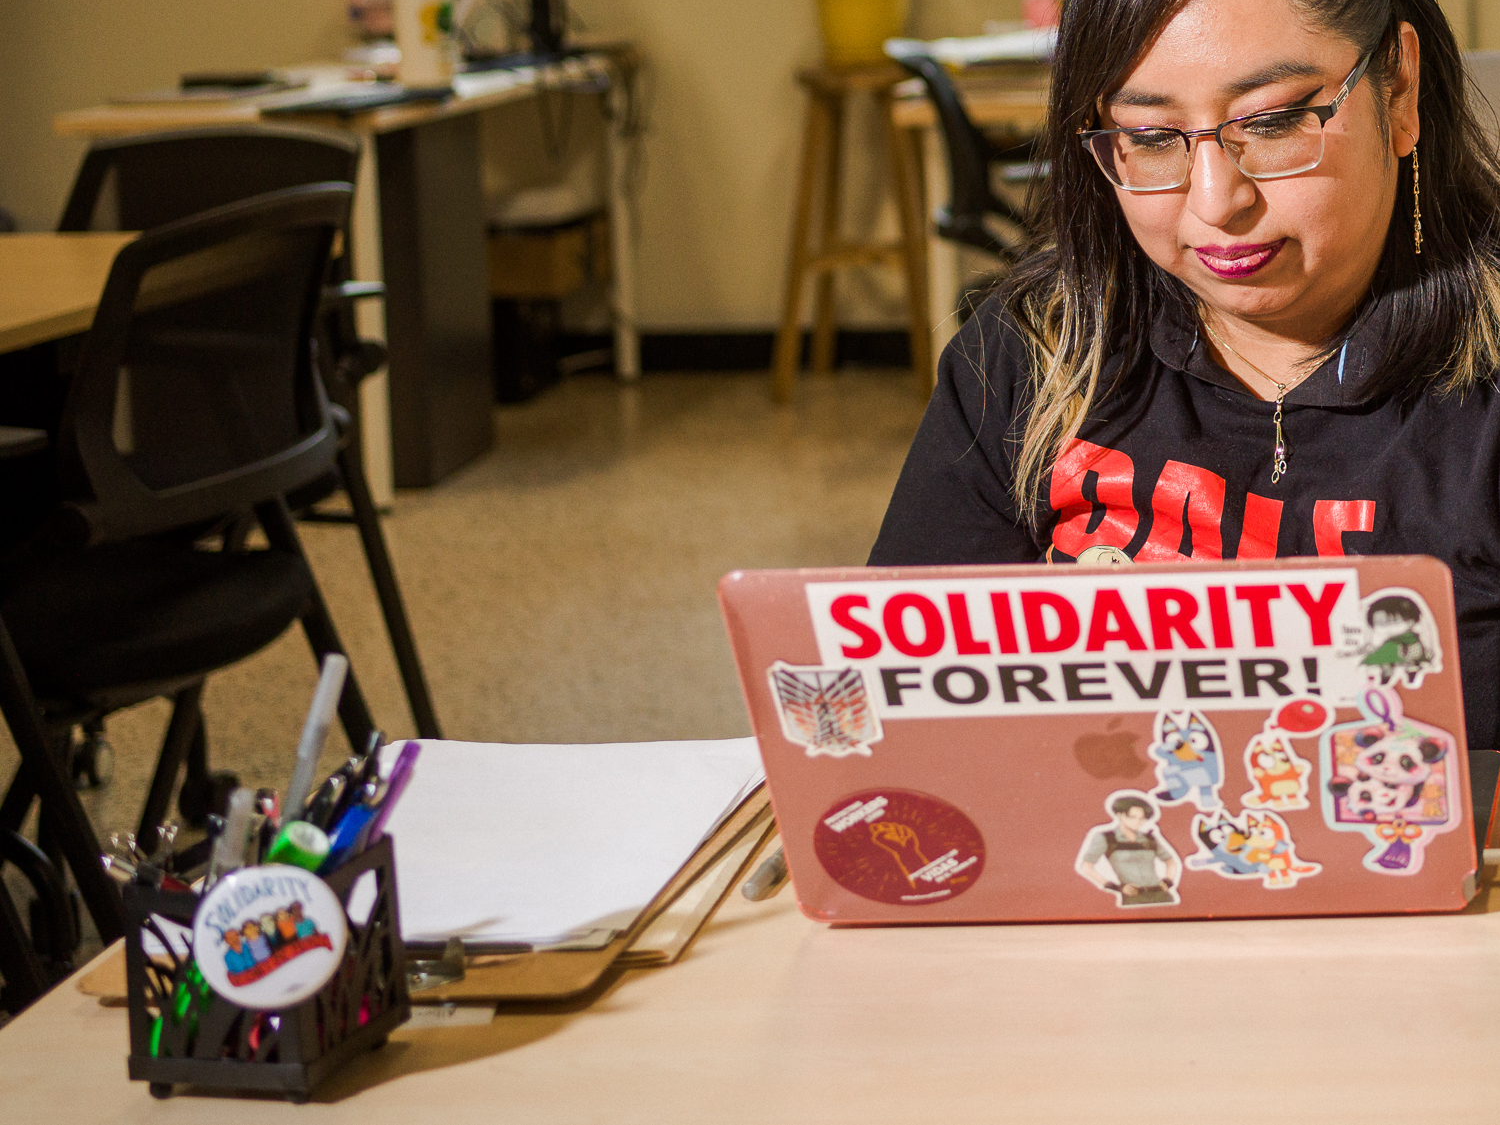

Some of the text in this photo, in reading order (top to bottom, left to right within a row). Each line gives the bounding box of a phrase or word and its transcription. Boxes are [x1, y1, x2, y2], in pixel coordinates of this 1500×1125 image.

[829, 582, 1346, 659] SOLIDARITY
[879, 656, 1322, 706] FOREVER!
[920, 857, 959, 882] VIDAS
[205, 876, 313, 947] SOLIDARITY
